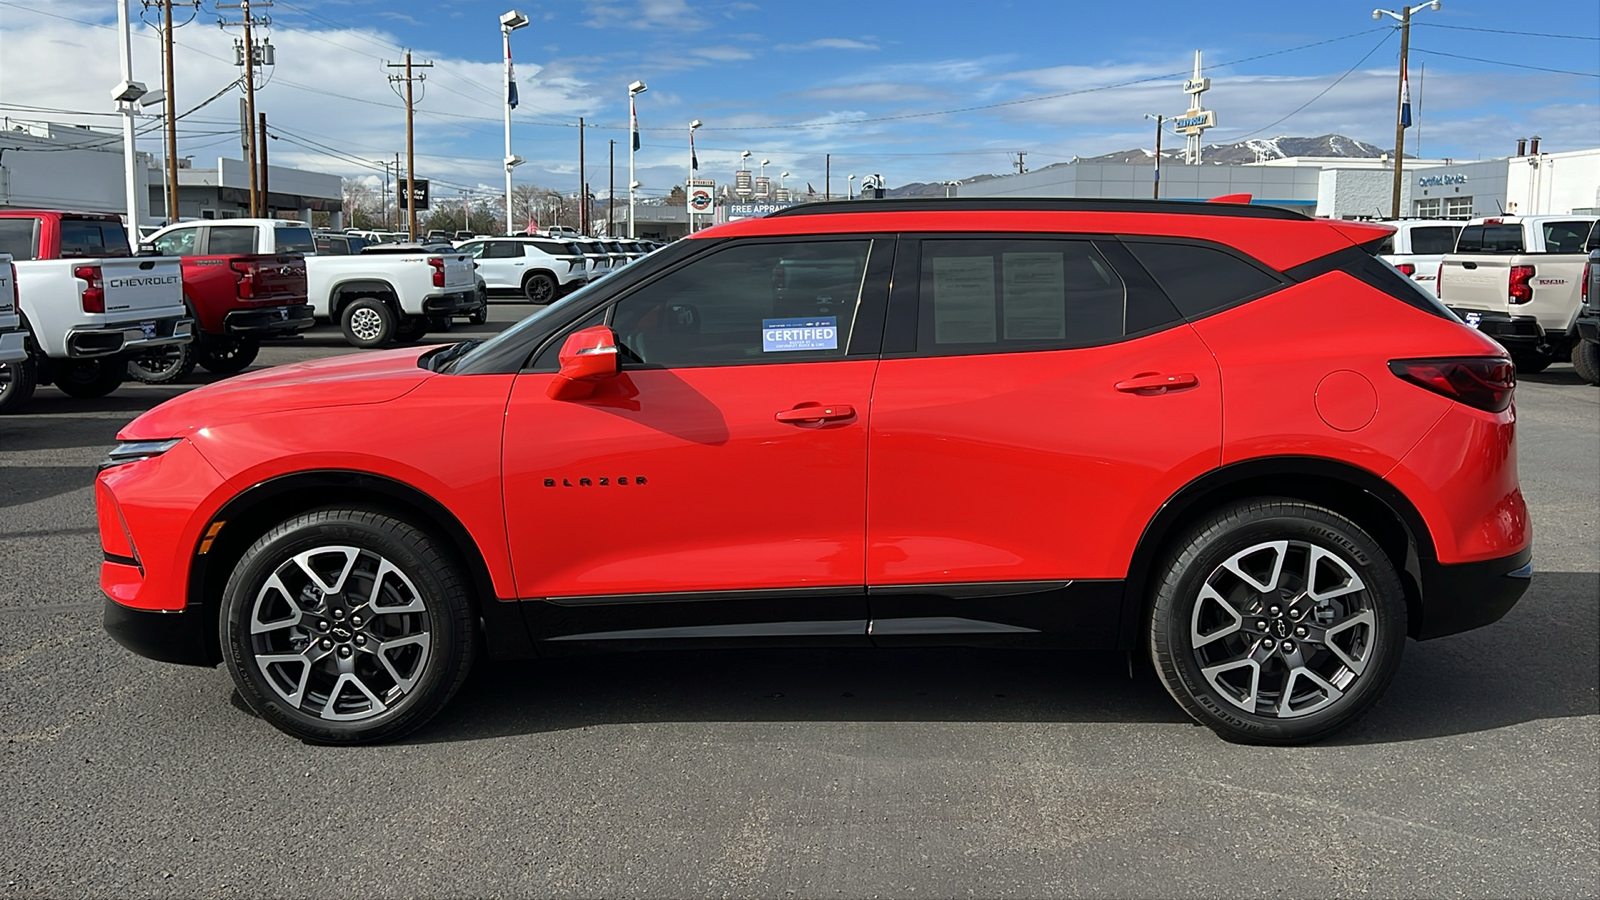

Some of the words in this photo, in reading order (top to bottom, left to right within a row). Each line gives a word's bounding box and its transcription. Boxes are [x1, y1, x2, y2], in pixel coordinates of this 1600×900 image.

[731, 205, 752, 213] FREE
[110, 276, 178, 288] CHEVROLET
[766, 328, 834, 341] CERTIFIED
[543, 476, 648, 487] BLAZER
[1308, 525, 1369, 564] MICHELIN
[1199, 696, 1260, 732] MICHELIN
